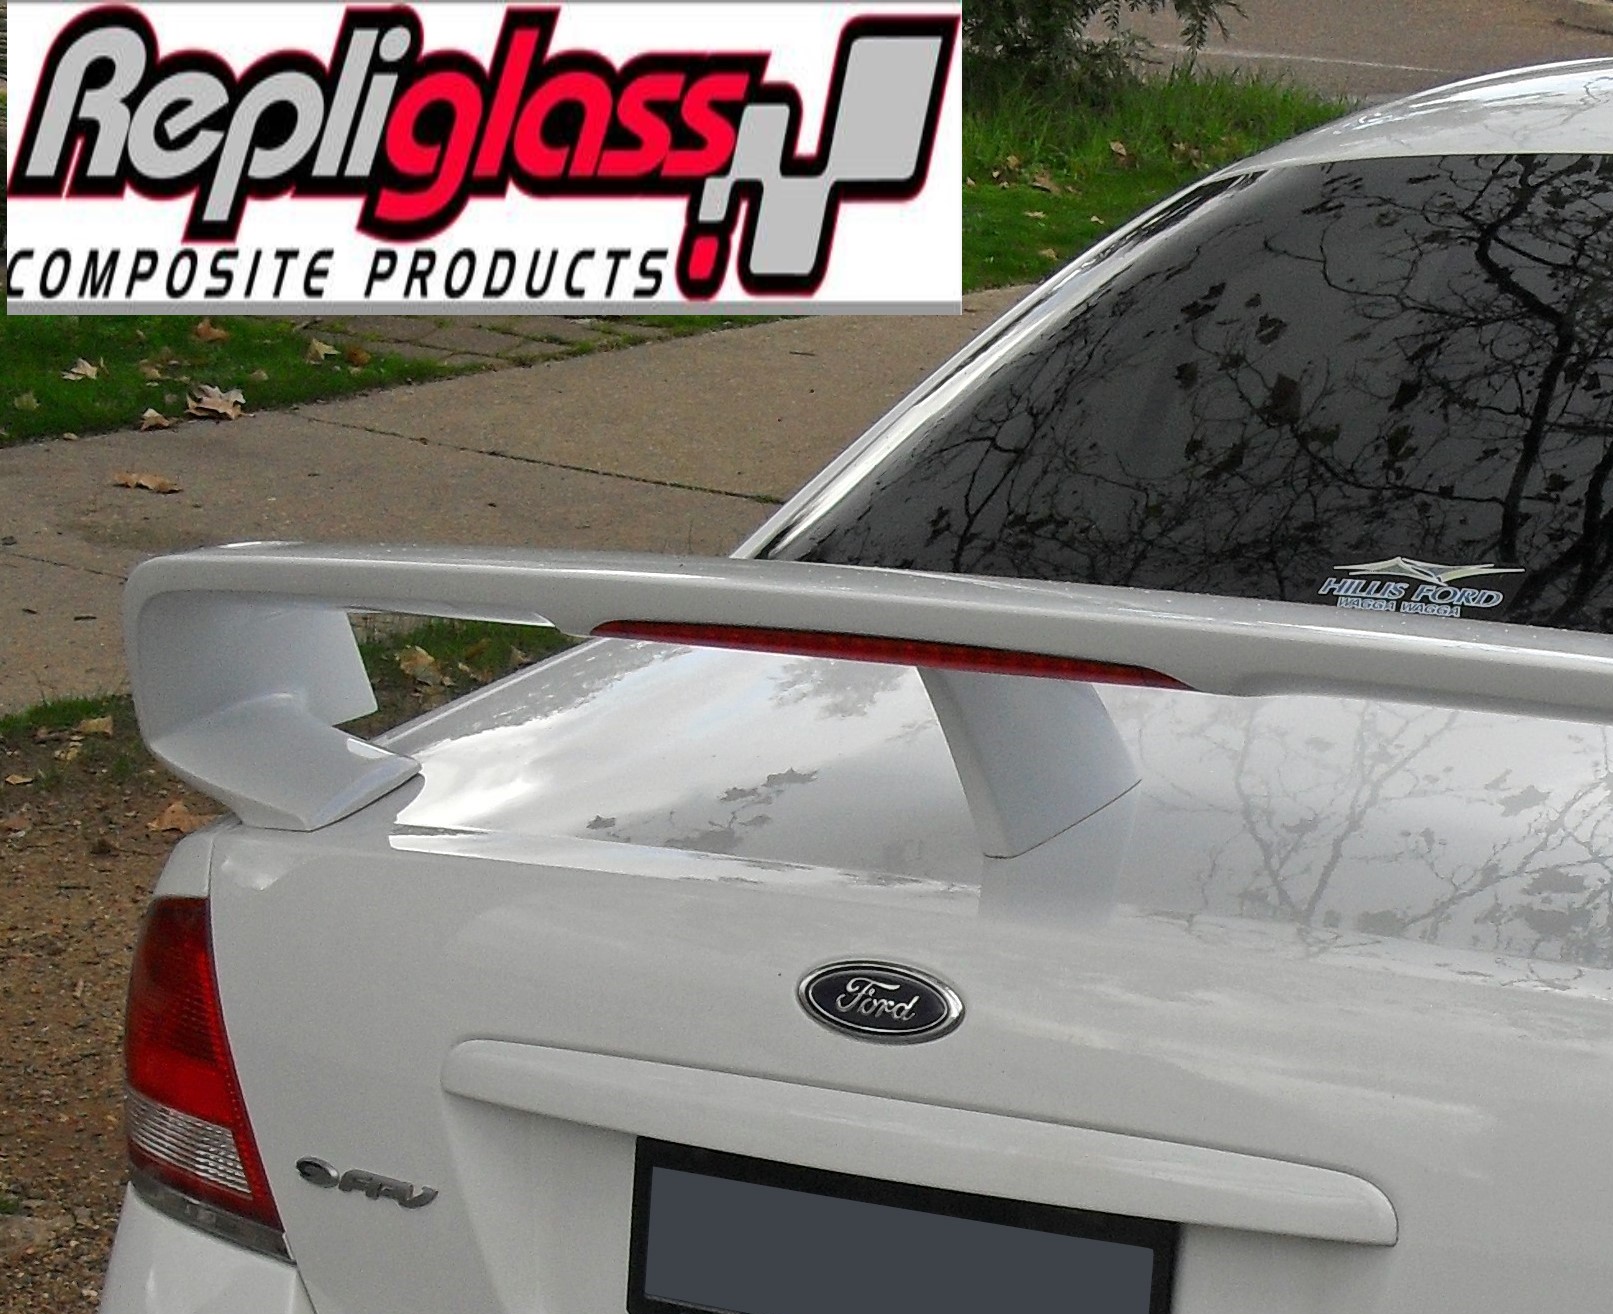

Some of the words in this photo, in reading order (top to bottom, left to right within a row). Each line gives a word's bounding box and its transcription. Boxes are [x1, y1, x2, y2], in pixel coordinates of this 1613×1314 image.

[1318, 577, 1409, 600] HILLIS
[1411, 584, 1504, 608] FORD
[1336, 596, 1396, 612] WAGGA
[1400, 601, 1461, 618] WAGGA
[835, 976, 920, 1021] Ford
